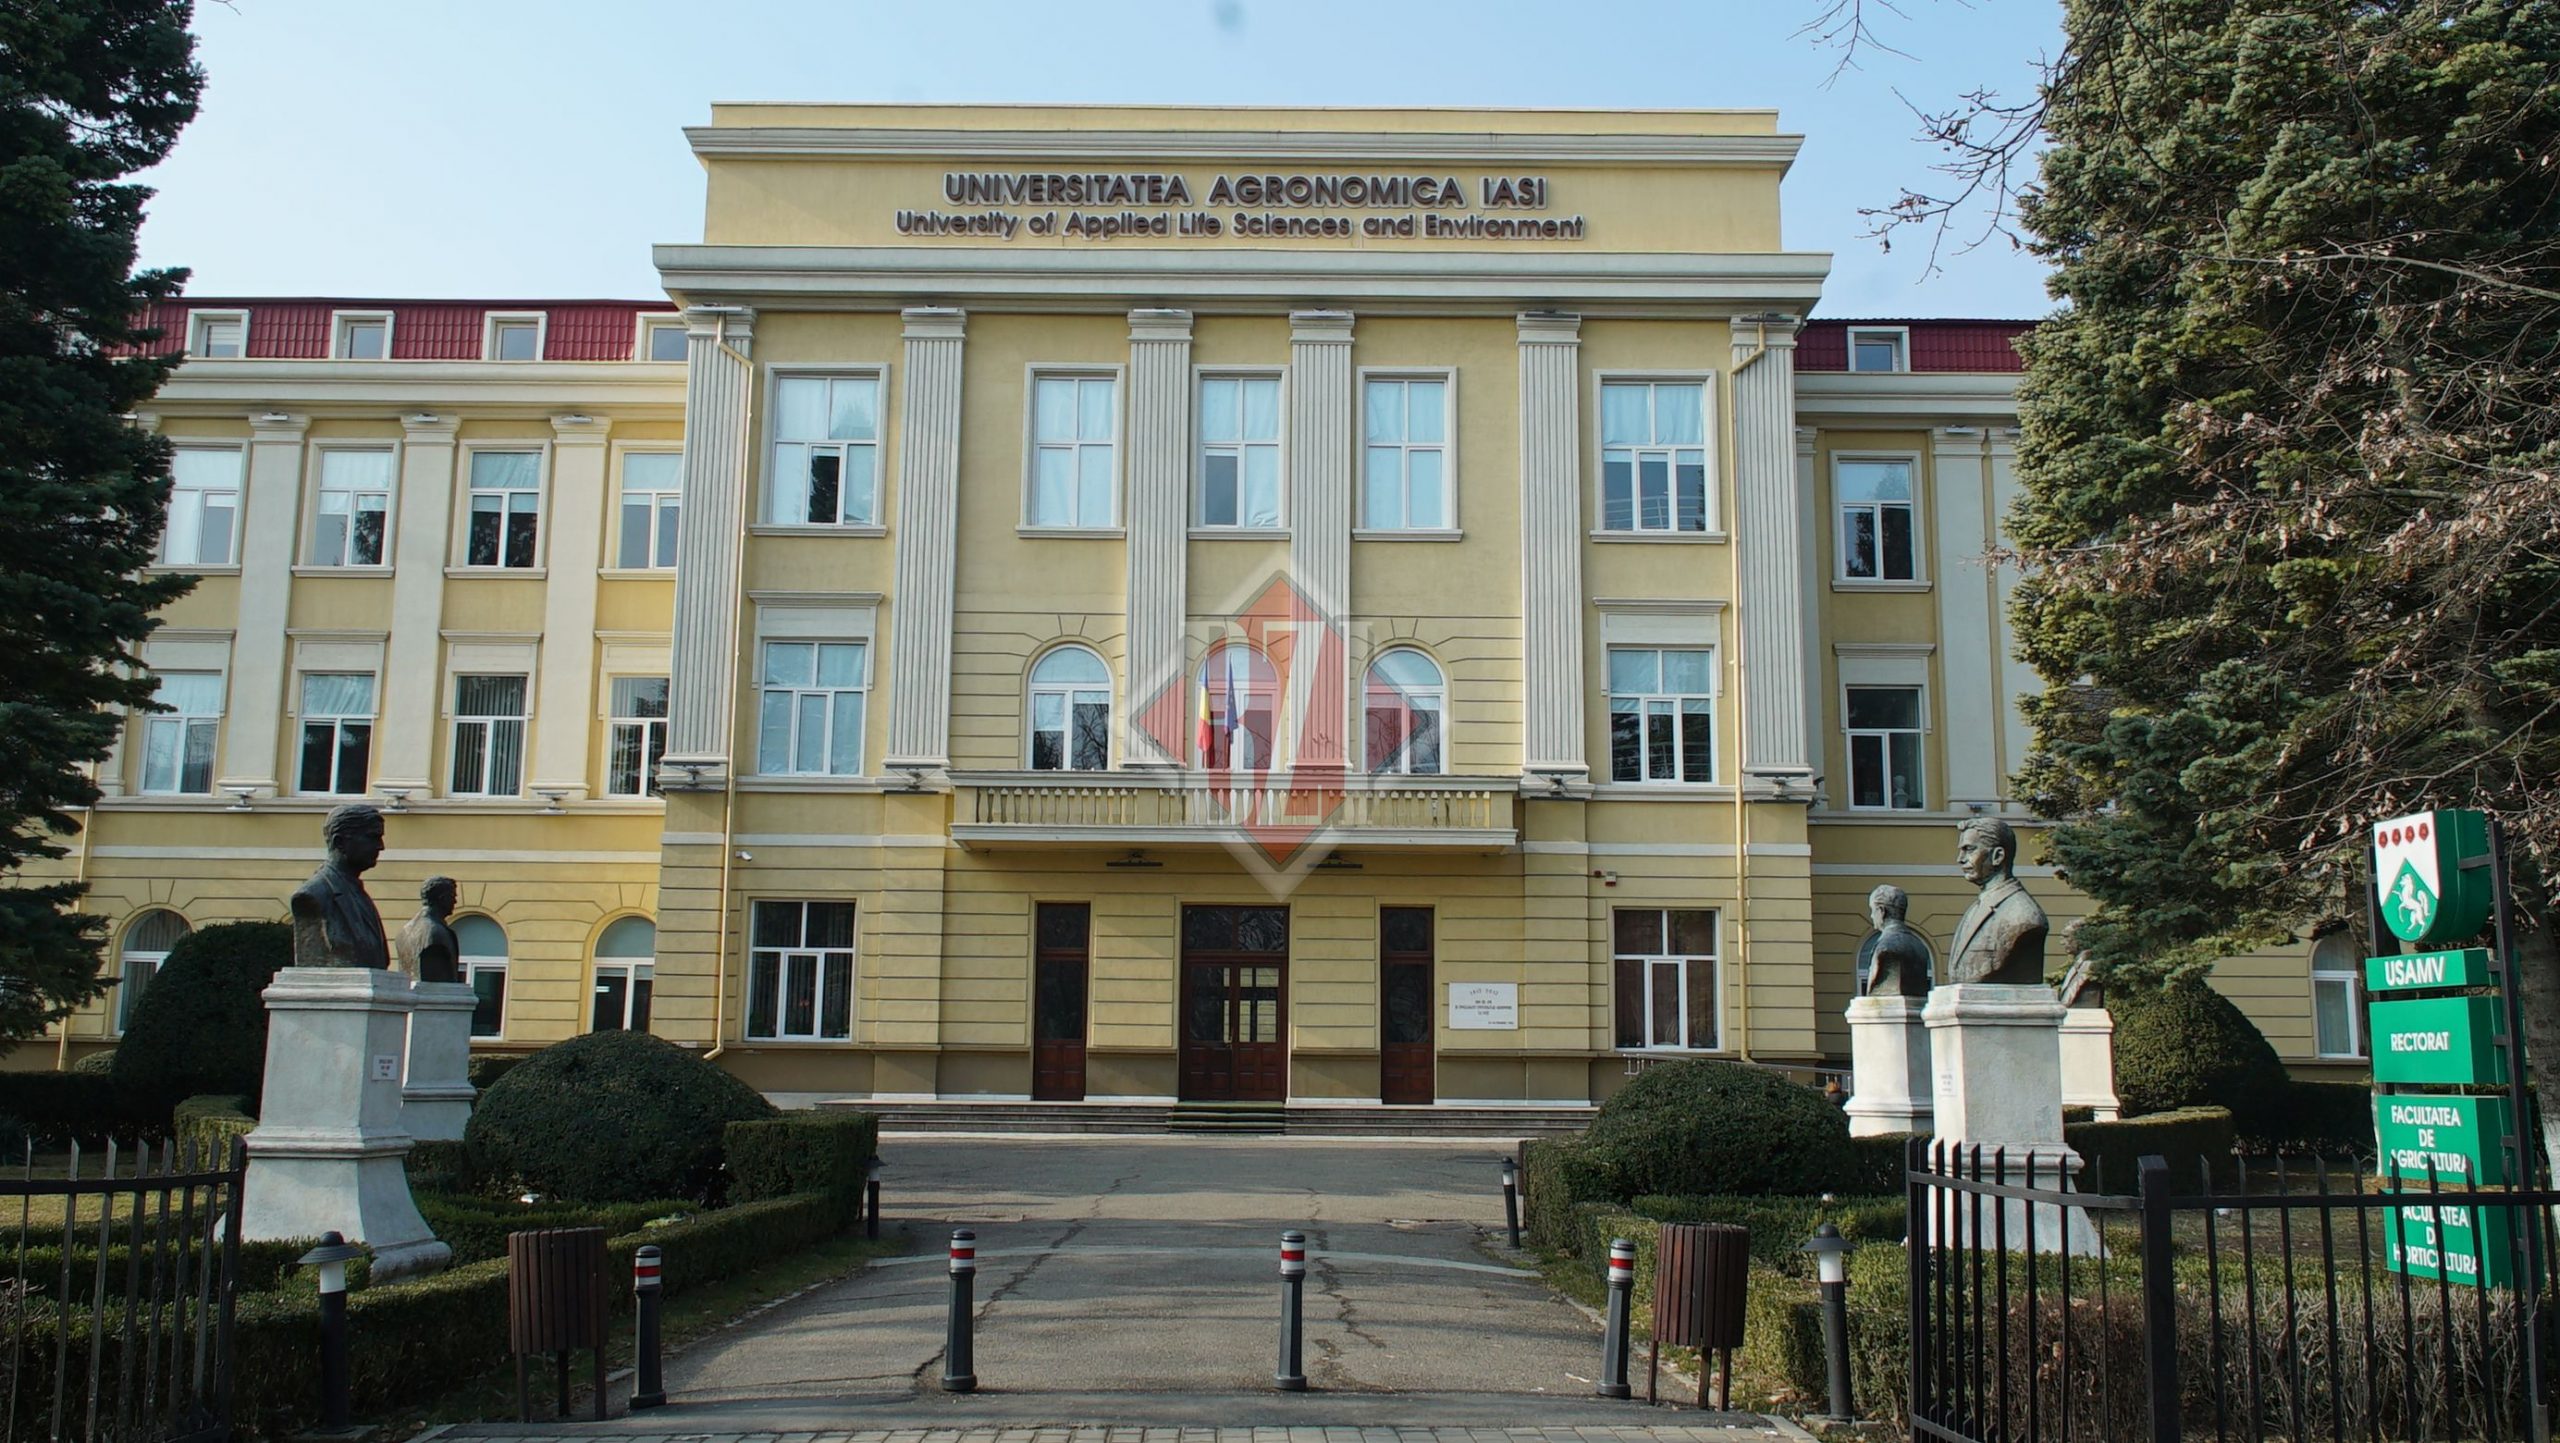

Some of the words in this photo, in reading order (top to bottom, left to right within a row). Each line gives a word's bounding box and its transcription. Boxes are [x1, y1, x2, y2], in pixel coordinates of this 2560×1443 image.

[945, 173, 1190, 203] UNIVERSITATEA
[1208, 175, 1466, 206] AGRONOMICA
[1481, 176, 1546, 207] IASI
[896, 210, 1020, 239] University
[1028, 211, 1055, 235] of
[1065, 212, 1168, 239] Applied
[1179, 212, 1222, 235] Life
[1233, 212, 1351, 236] Sciences
[1362, 214, 1415, 237] and
[1424, 215, 1583, 239] Environment
[2384, 956, 2445, 986] USAMV
[2390, 1031, 2449, 1051] RECTORAT
[2391, 1105, 2461, 1127] FACULTATEA
[2418, 1128, 2435, 1148] DE
[2397, 1205, 2469, 1228] ACULATEA
[2425, 1226, 2439, 1245] D
